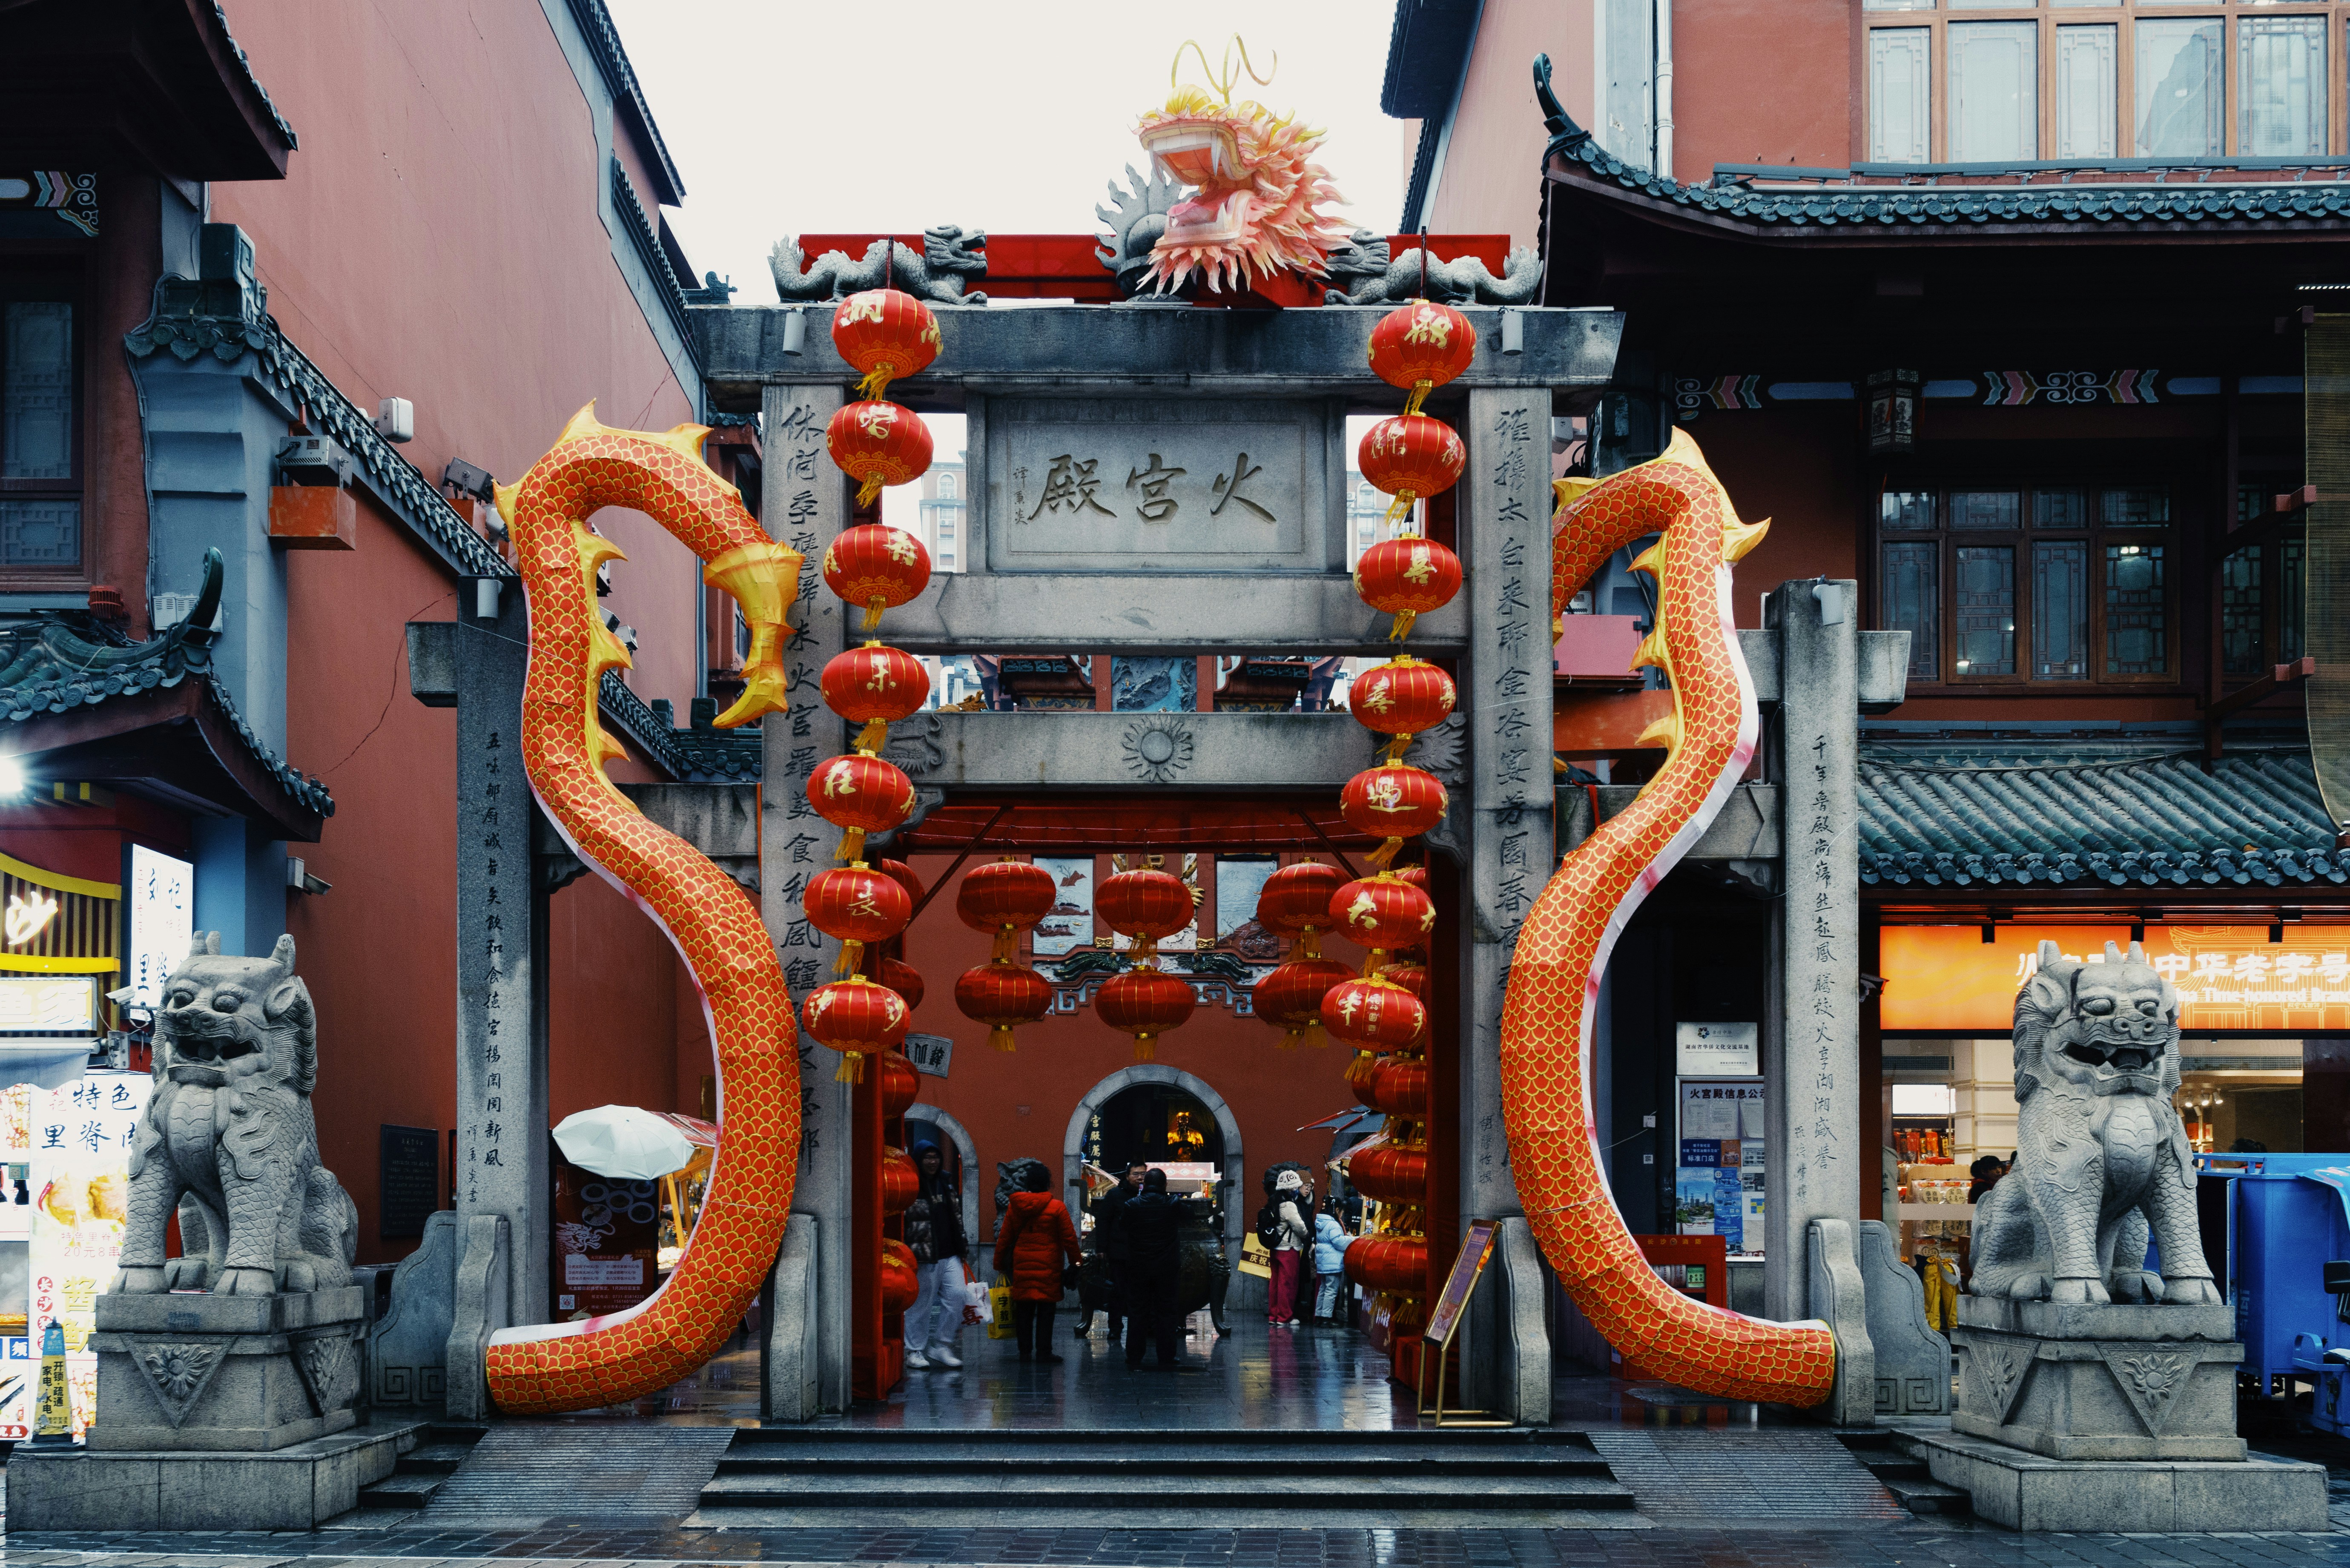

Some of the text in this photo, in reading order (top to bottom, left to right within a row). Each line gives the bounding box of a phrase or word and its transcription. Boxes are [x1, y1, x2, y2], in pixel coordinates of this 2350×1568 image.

[2154, 952, 2350, 983] 中华老字号
[2176, 988, 2198, 1002] ina
[2202, 987, 2306, 1002] Time-honored
[73, 1081, 137, 1110] 特色
[1249, 1254, 1270, 1267] 庆祝
